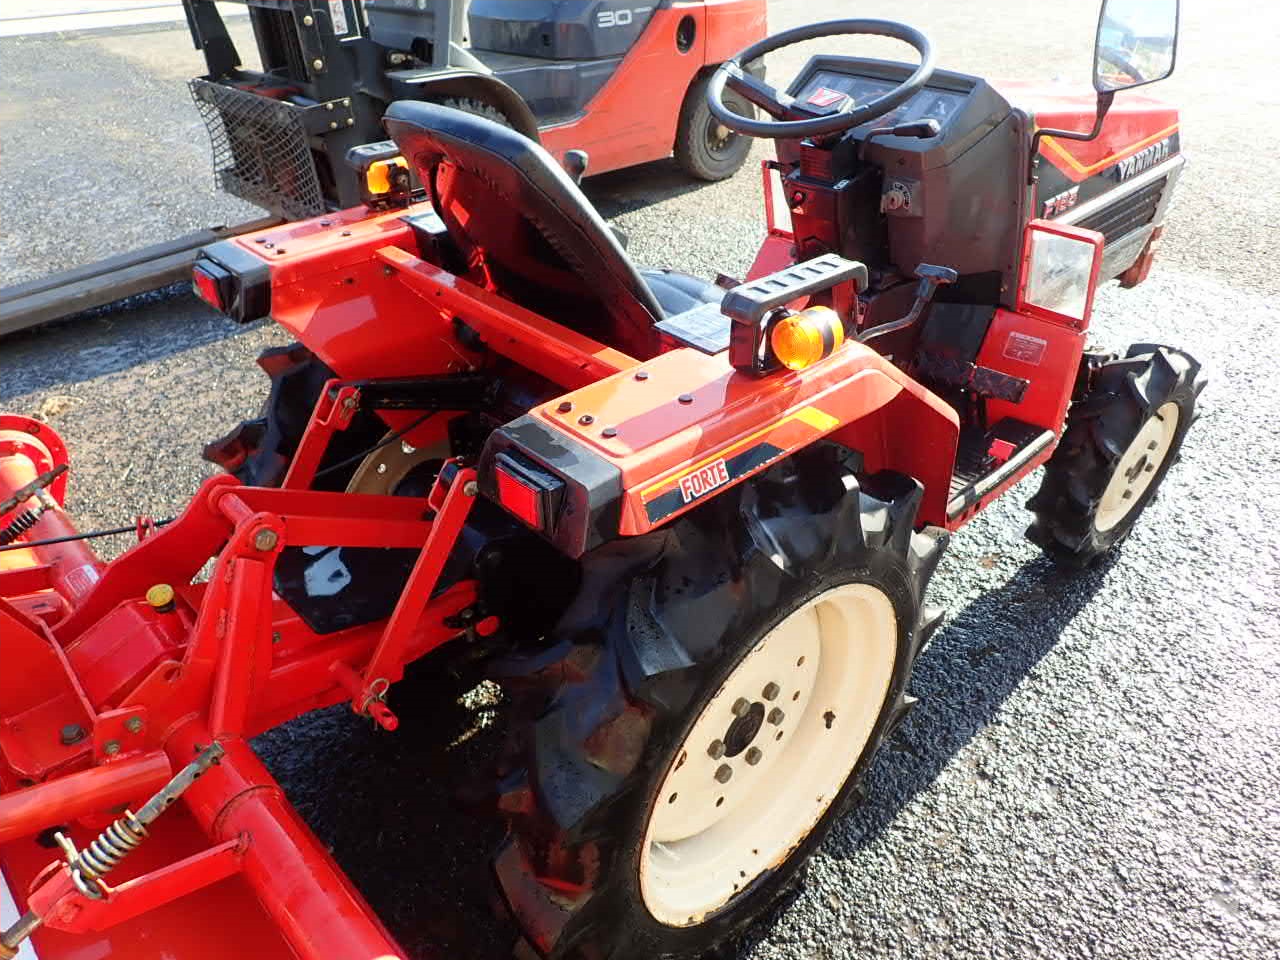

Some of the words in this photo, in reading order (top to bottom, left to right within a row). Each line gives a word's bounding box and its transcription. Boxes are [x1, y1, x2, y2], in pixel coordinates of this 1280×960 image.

[597, 9, 633, 28] 30
[1119, 137, 1169, 182] YANMAR
[679, 457, 730, 504] FORTE
